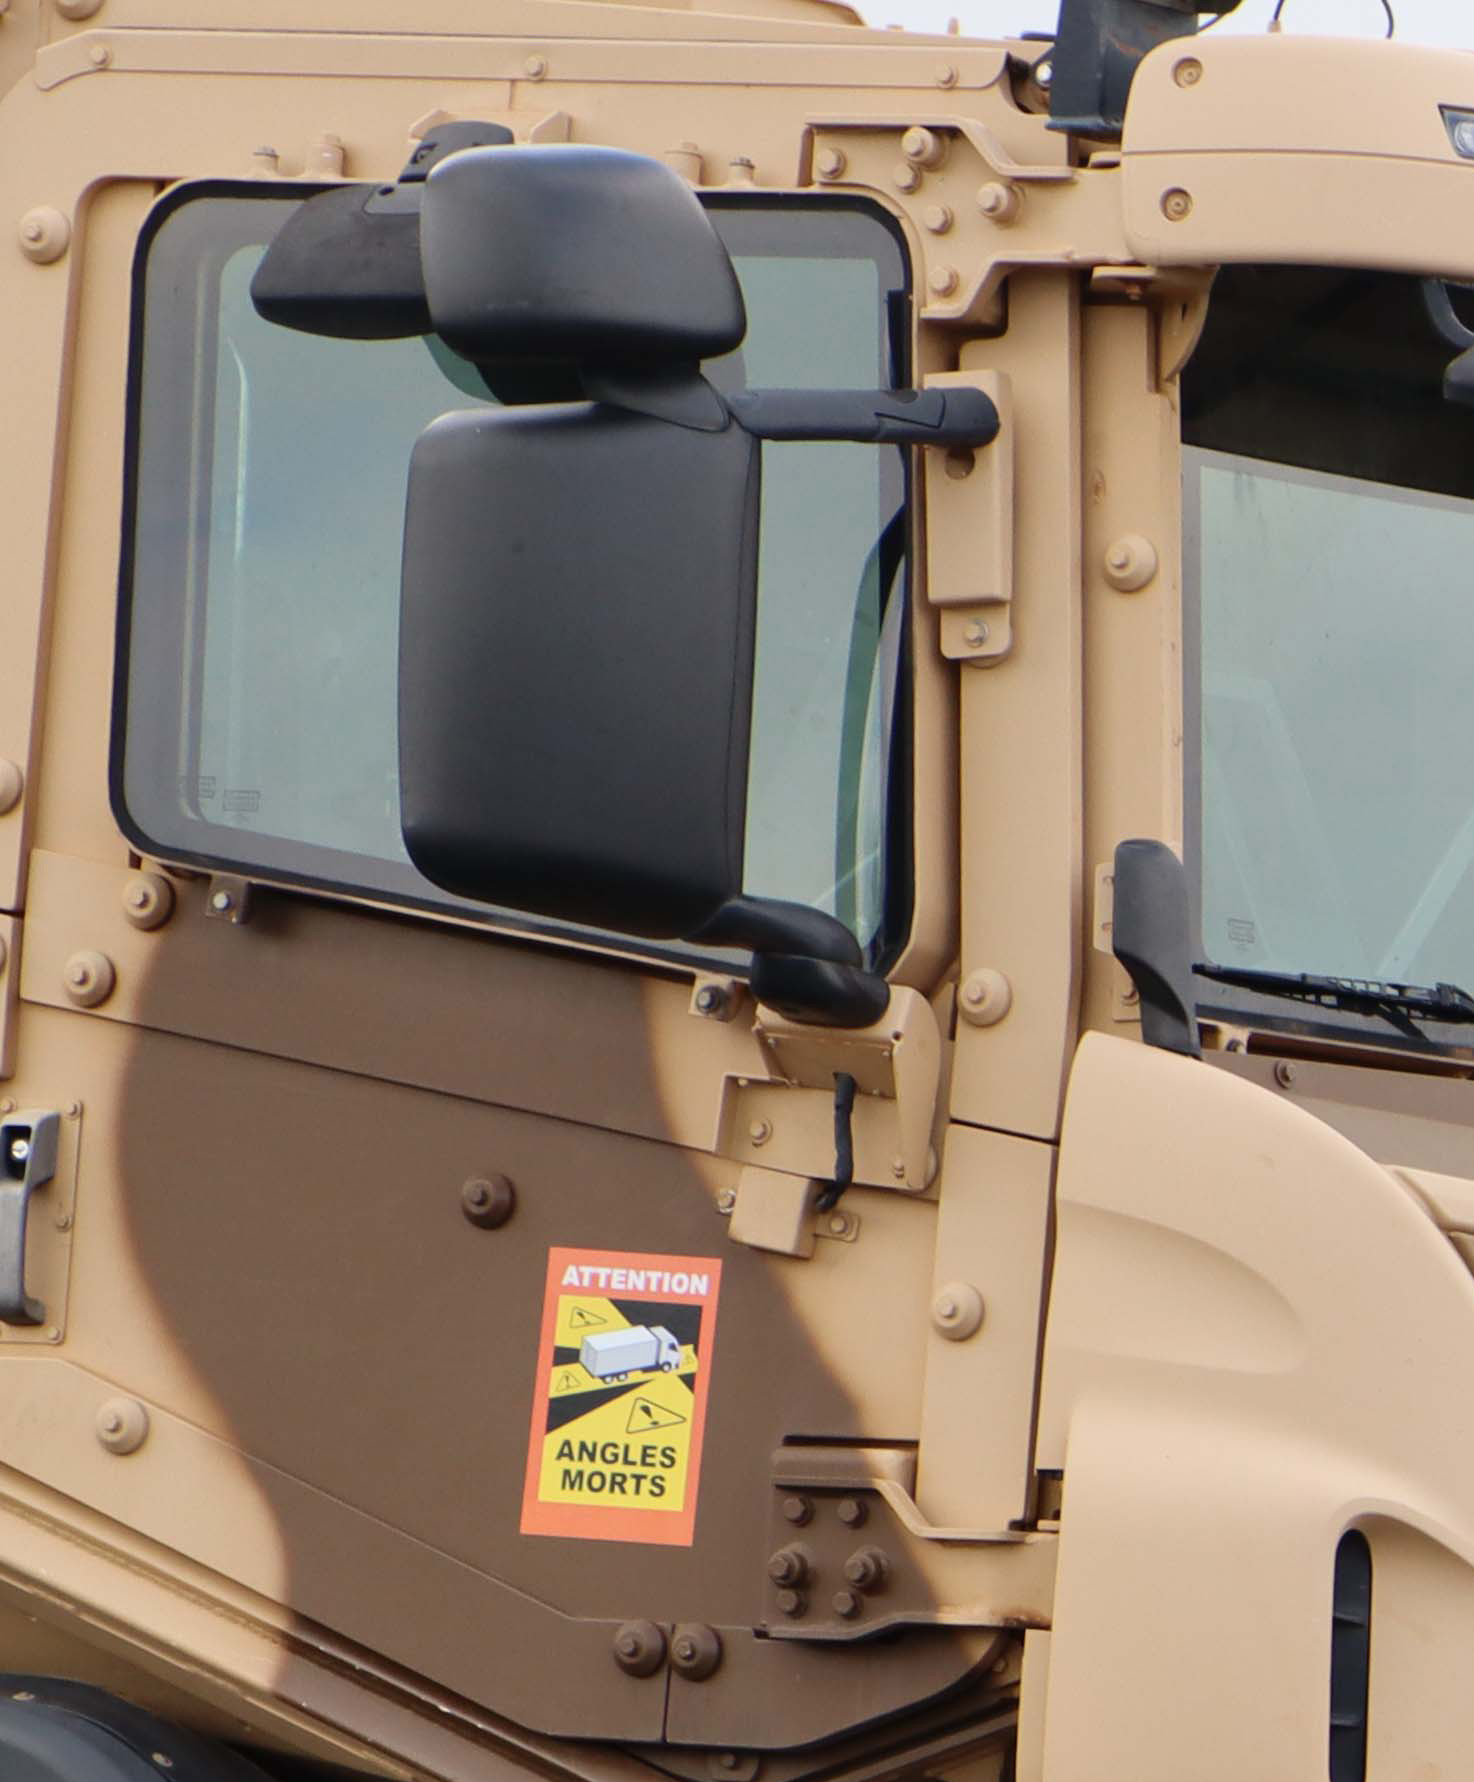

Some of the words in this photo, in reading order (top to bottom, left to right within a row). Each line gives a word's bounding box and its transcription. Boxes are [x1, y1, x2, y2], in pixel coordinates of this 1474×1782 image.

[561, 1264, 710, 1296] ATTENTION
[556, 1440, 677, 1470] ANGLES
[561, 1469, 667, 1498] MORTS
